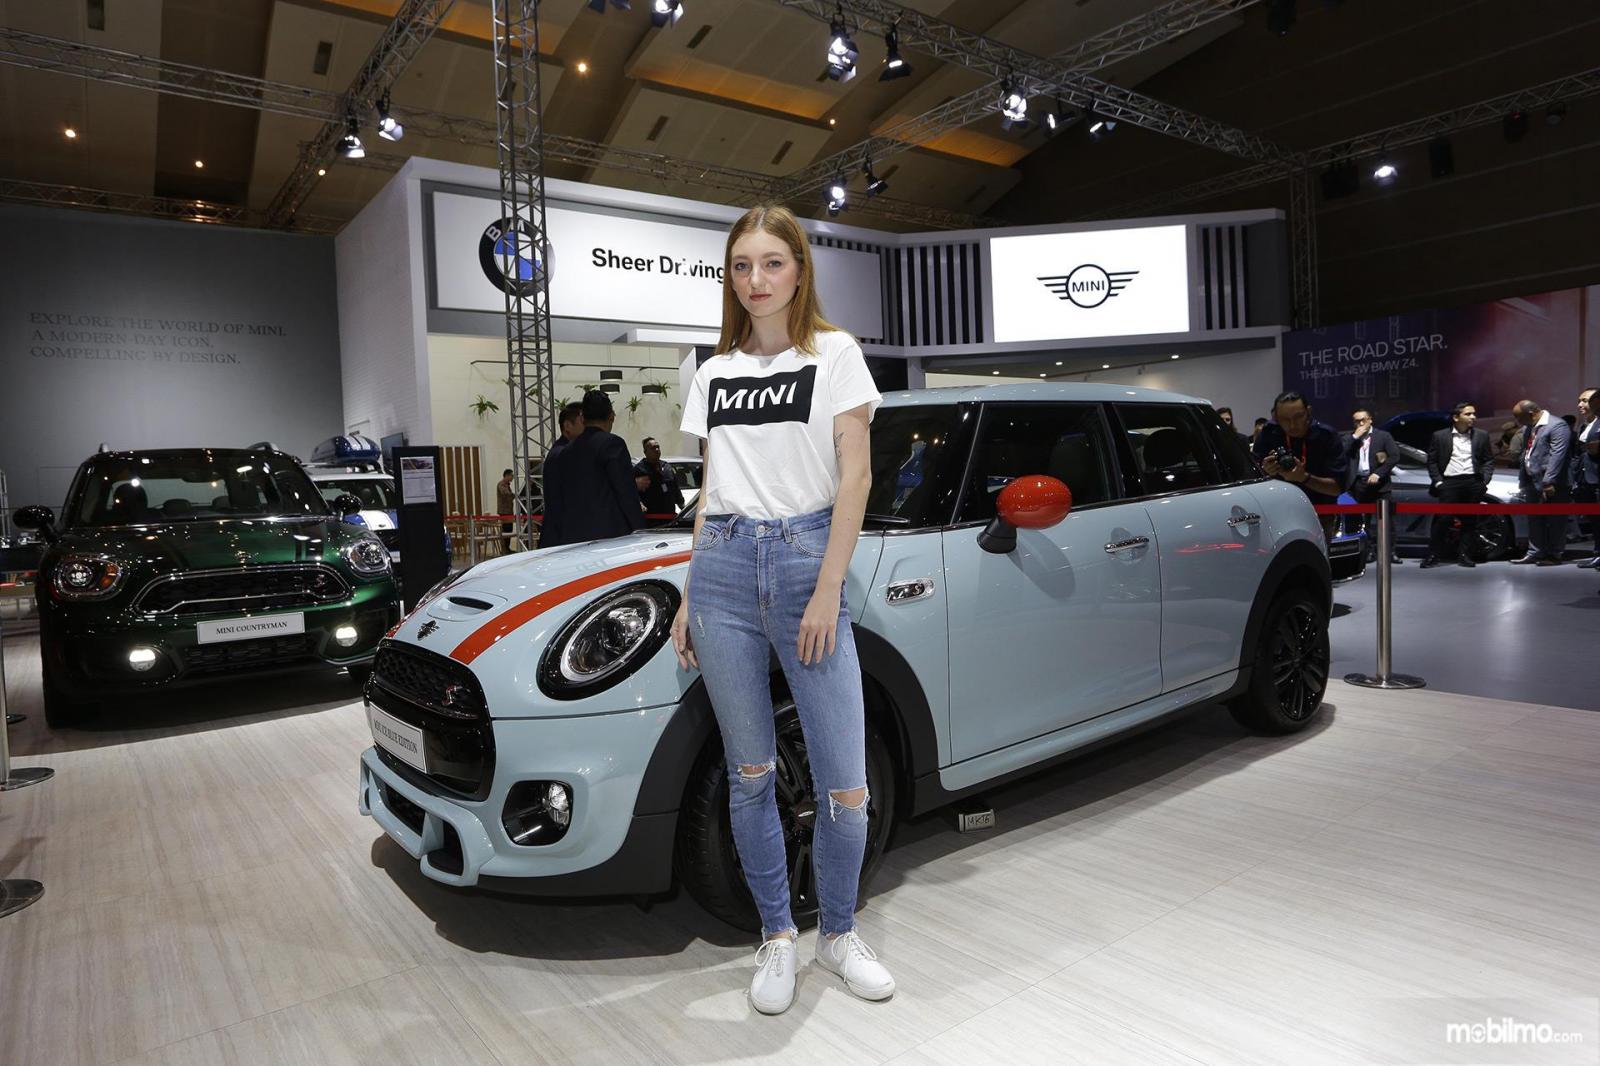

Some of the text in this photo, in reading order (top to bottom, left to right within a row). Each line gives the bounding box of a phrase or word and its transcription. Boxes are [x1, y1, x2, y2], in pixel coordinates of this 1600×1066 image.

[591, 247, 655, 272] Sheer
[1071, 280, 1105, 293] MINI
[29, 311, 287, 337] EXPLORE THE WORLD OF MINI.
[31, 329, 44, 342] A
[29, 346, 147, 362] COMPELLING
[152, 350, 174, 363] BY
[1299, 333, 1448, 367] THE ROAD STAR.
[1299, 368, 1321, 380] THE
[1371, 360, 1400, 373] BMW
[713, 381, 798, 413] MINI
[215, 621, 288, 635] MINI COUNTRYMAN
